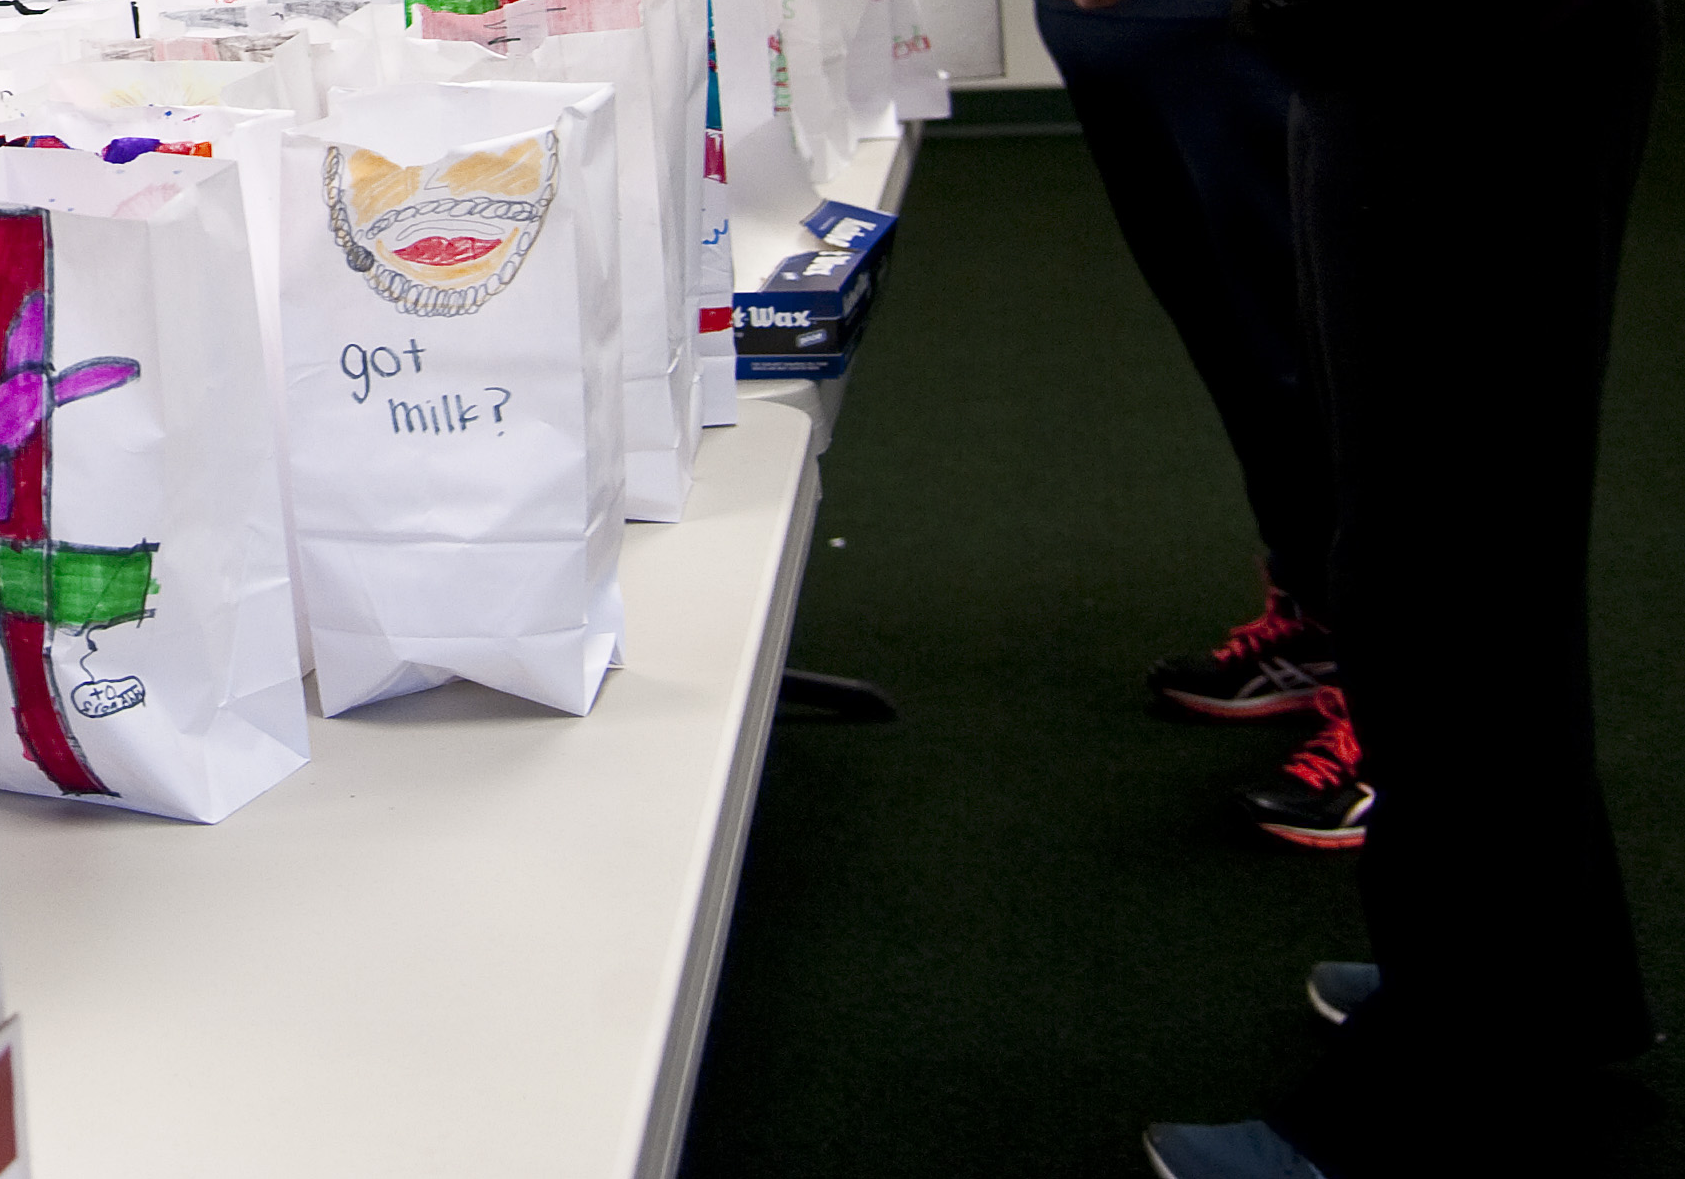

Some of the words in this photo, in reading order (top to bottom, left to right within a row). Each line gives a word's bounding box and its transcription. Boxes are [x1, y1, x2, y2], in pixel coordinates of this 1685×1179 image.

[748, 305, 812, 329] Wax
[340, 338, 427, 404] got
[387, 386, 512, 437] milk?
